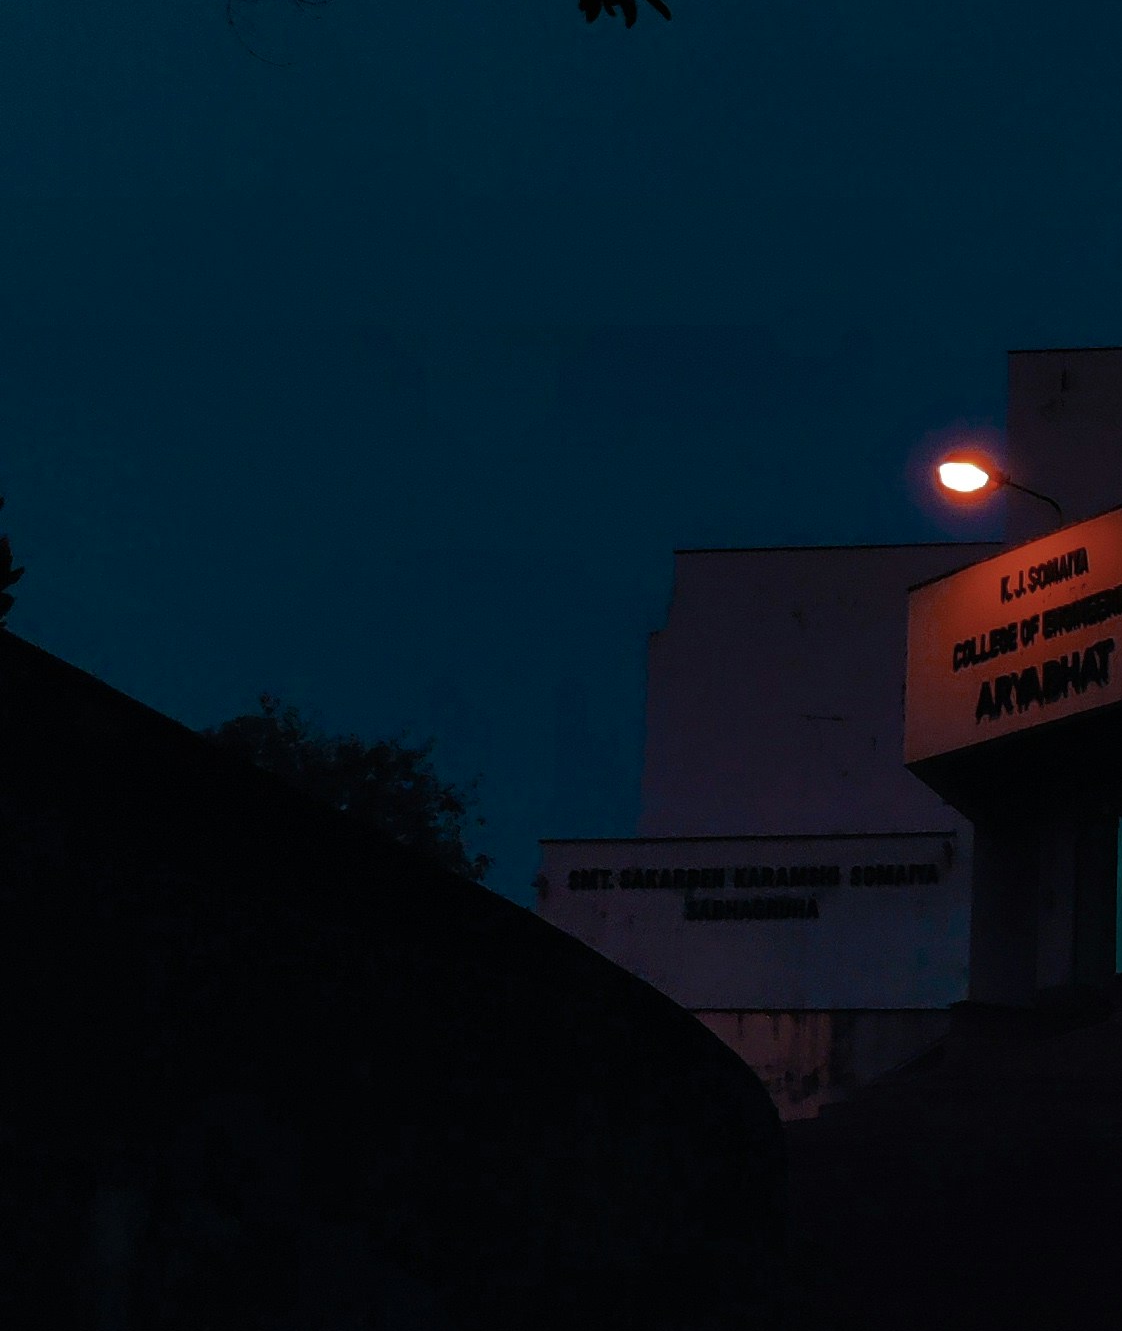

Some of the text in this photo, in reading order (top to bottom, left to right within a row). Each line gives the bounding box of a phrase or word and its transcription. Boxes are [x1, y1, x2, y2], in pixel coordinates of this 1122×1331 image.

[953, 622, 1018, 672] COLLEGE
[1020, 614, 1040, 647] OF
[976, 638, 1115, 725] ARYABHAT
